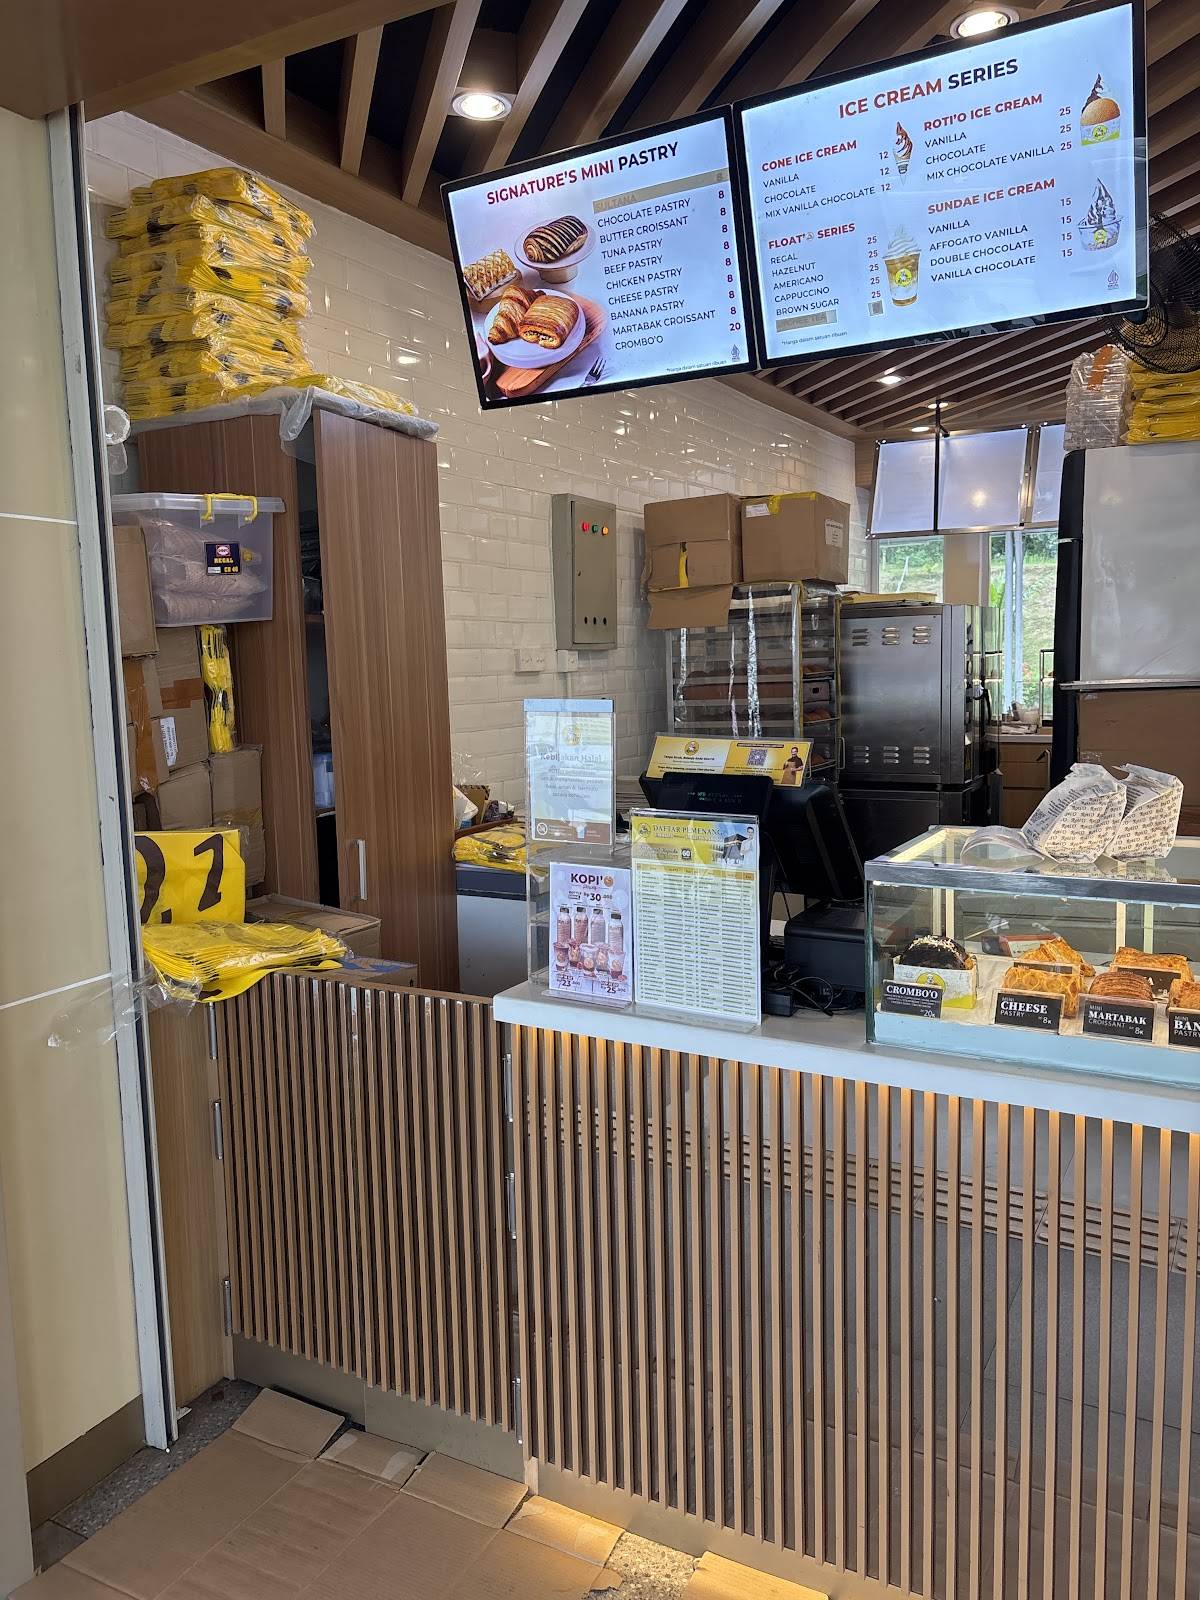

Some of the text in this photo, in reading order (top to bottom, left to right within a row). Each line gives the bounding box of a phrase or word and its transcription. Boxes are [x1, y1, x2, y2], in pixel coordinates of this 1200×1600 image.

[839, 59, 1018, 119] ICE CREAM SERIES
[924, 94, 1042, 131] ROTI'O ICE CREAM
[924, 107, 1071, 148] VANILLA 25
[762, 140, 857, 172] CONE ICE CREAM
[925, 124, 1072, 165] CHOCOLATE 25
[926, 140, 1072, 181] MIX CHOCOLATE VANILLA 25
[487, 142, 678, 204] SIGNATURE'S MINI PASTRY
[763, 151, 889, 188] VANILLA 12
[764, 168, 890, 204] CHOCOLATE 12
[598, 190, 724, 228] CHOCOLATE PASTRY 8
[766, 183, 891, 218] MIX VANILLA CHOCOLATE 12
[927, 178, 1055, 214] SUNDAE ICE CREAM
[600, 207, 726, 244] BUTTER CROISSANT 8
[817, 223, 856, 238] SERIES
[928, 198, 1072, 234] VANILLA 15
[602, 224, 728, 260] TUNA PASTRY 8
[770, 236, 877, 264] REGAL 25
[929, 216, 1072, 251] AFFOGATO VANILLA 15
[930, 233, 1072, 267] DOUBLE CHOCOLATE 15
[604, 241, 729, 274] BEEF PASTRY 8
[606, 258, 731, 290] CHICKEN PASTRY 8
[772, 250, 878, 277] HAZELNUT 25
[931, 249, 1073, 282] VANILLA CHOCOLATE 15
[608, 274, 733, 305] CHEESE PASTRY 8
[774, 264, 879, 290] AMERICANO 25
[775, 277, 880, 303] CAPPUCCINO 25
[610, 290, 734, 320] BANANA PASTRY 8
[613, 306, 736, 336] MARTABAK CROISSANT 8
[776, 304, 809, 316] BROWN
[811, 299, 840, 310] SUGAR
[615, 322, 740, 350] CROMBO'O 20
[653, 825, 680, 833] DAFTAR
[886, 985, 938, 999] CROMBO'O
[1000, 1001, 1048, 1014] CHEESE
[1088, 1011, 1146, 1025] MARTABAK
[1088, 1019, 1126, 1028] CROISSANT
